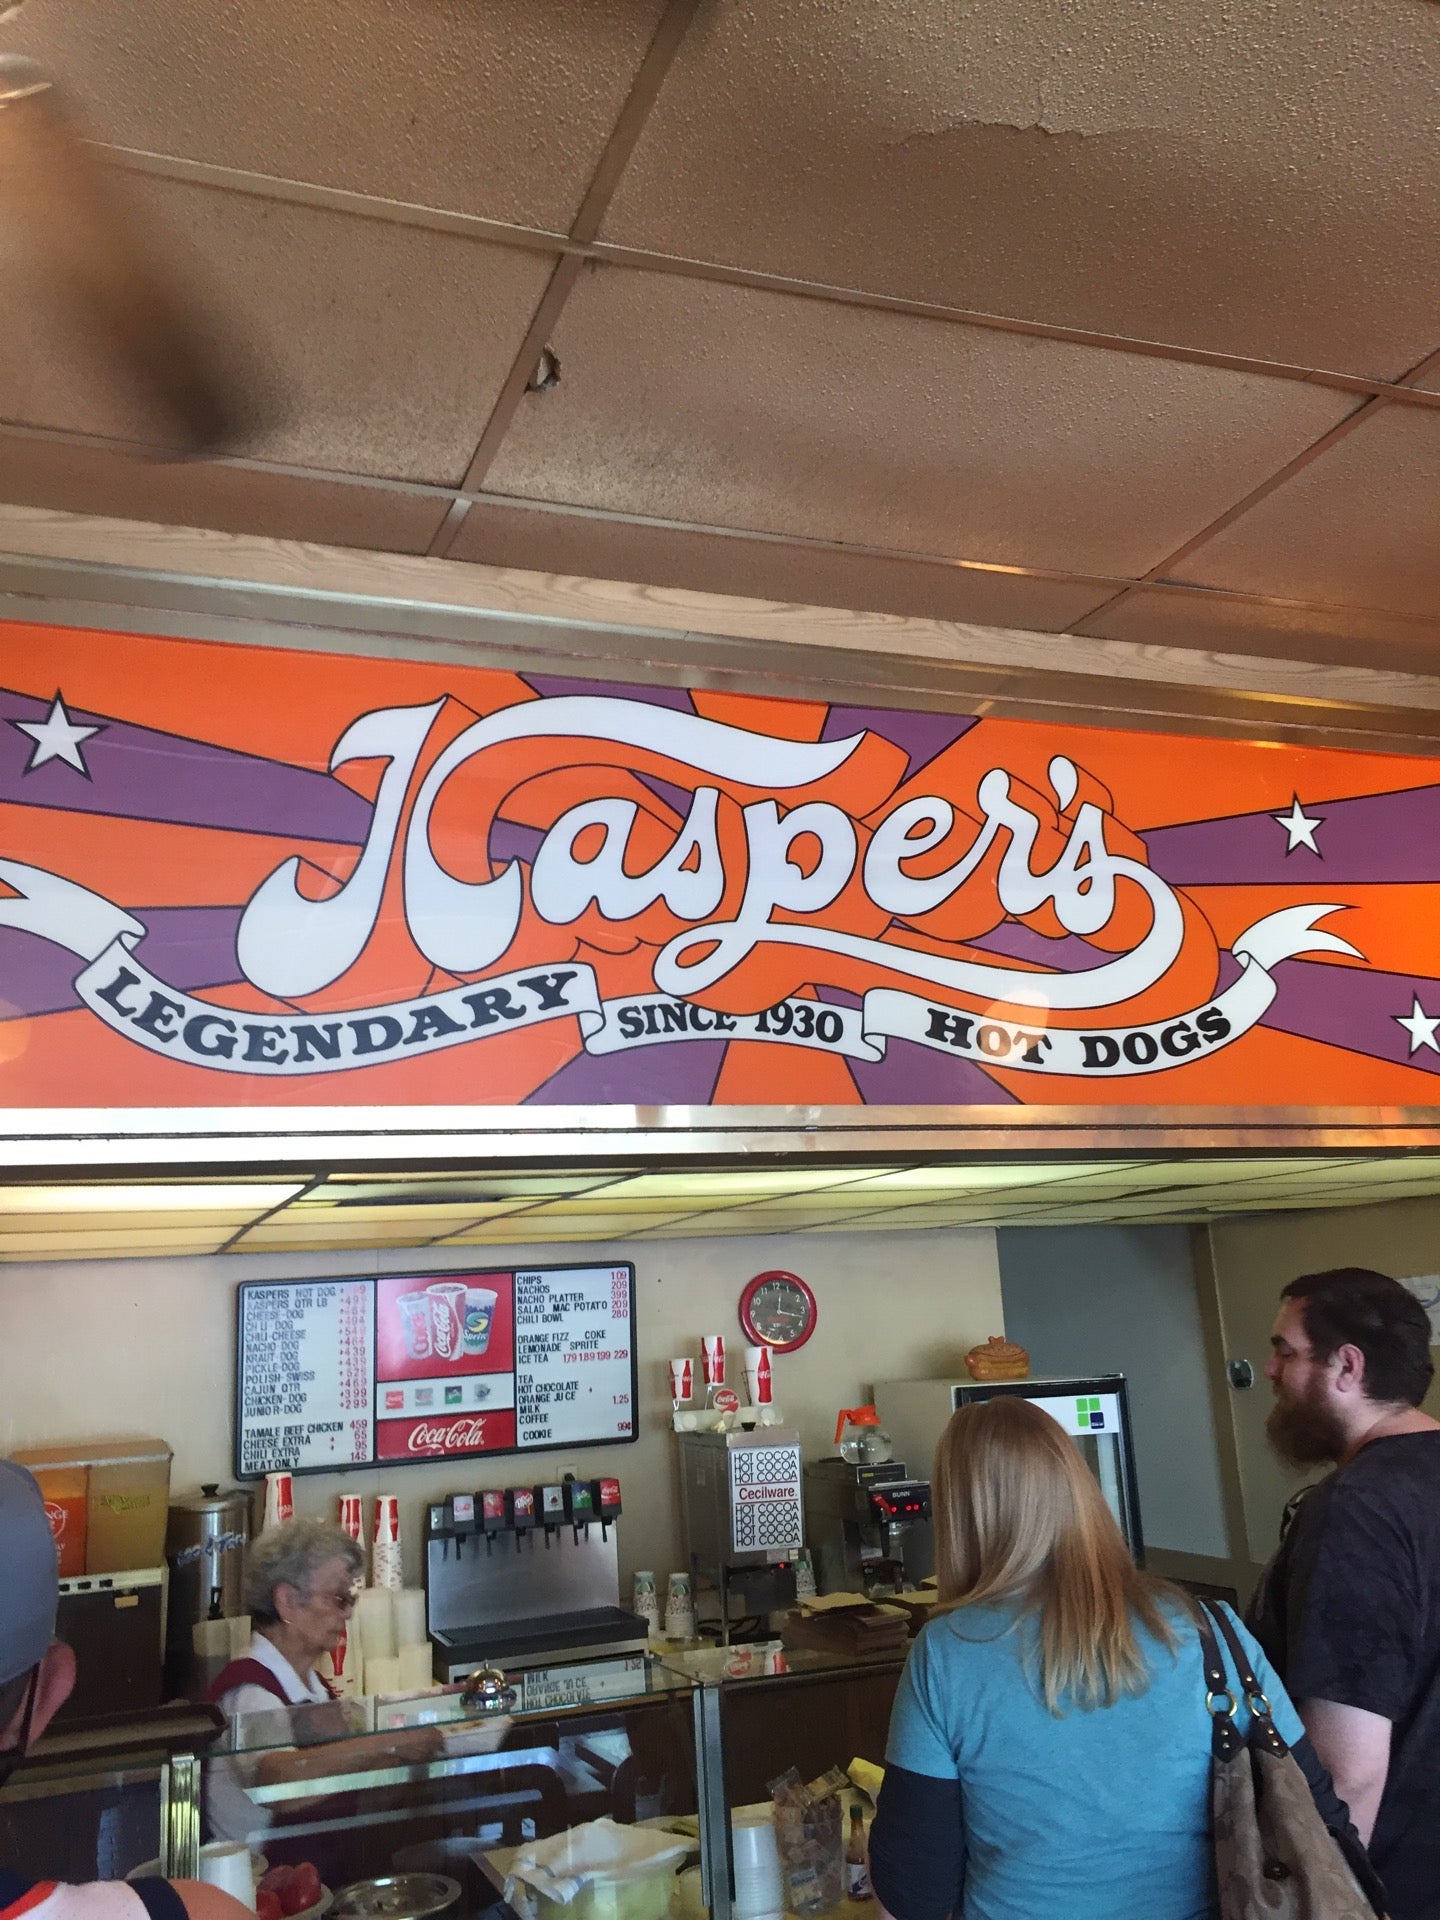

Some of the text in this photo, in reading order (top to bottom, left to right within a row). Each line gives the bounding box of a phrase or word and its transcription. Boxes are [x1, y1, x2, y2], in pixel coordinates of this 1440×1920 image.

[236, 694, 1185, 1010] Kasper's
[94, 965, 577, 1065] LEGENDARY
[618, 1003, 843, 1043] SINCE 1930
[924, 1006, 1232, 1069] HOT DOGS
[517, 1271, 626, 1285] CHIPS 109
[248, 1289, 289, 1300] KASPERS
[296, 1288, 313, 1298] HOT
[317, 1286, 336, 1296] DOG
[518, 1280, 627, 1294] NACHOS 209
[761, 1287, 768, 1295] 11
[773, 1282, 780, 1291] 12
[247, 1300, 289, 1310] KASPERS
[294, 1298, 312, 1308] QTR
[317, 1298, 328, 1307] LB
[518, 1290, 627, 1304] NACHO PLATTER 399
[753, 1297, 761, 1306] 10
[518, 1300, 628, 1314] SALAD MAC POTATO 209
[517, 1314, 538, 1324] CHILI
[542, 1313, 564, 1323] BOWL
[518, 1330, 606, 1344] ORANGE FIZZ COKE
[518, 1340, 598, 1354] LEMONADE SPRITE
[518, 1350, 628, 1364] ICE TEA 179 189 199 229
[518, 1374, 534, 1384] TEA
[244, 1385, 276, 1396] CAJUN
[282, 1383, 300, 1392] QTR
[345, 1388, 366, 1398] 399
[518, 1381, 579, 1394] HOT CHOCOLATE
[345, 1399, 367, 1409] 299
[518, 1393, 550, 1404] ORANGE
[520, 1404, 540, 1414] MILK
[519, 1413, 549, 1424] COFFEE
[245, 1420, 367, 1438] TAMALE BEEF CHICKEN 459
[523, 1428, 552, 1440] COOKIE
[244, 1430, 366, 1450] CHEESE EXTRA 65
[244, 1441, 366, 1460] CHILI EXTRA 95
[351, 1452, 366, 1461] 145
[734, 1450, 797, 1464] HOT COCOA
[735, 1460, 797, 1474] HOT COCOA
[735, 1470, 798, 1484] HOT COCOA
[739, 1486, 795, 1500] Cecilware
[736, 1502, 799, 1516] HOT COCOA
[736, 1512, 799, 1526] HOT COCOA
[736, 1522, 800, 1536] HOT COCOA
[736, 1532, 800, 1547] HOT COCOA
